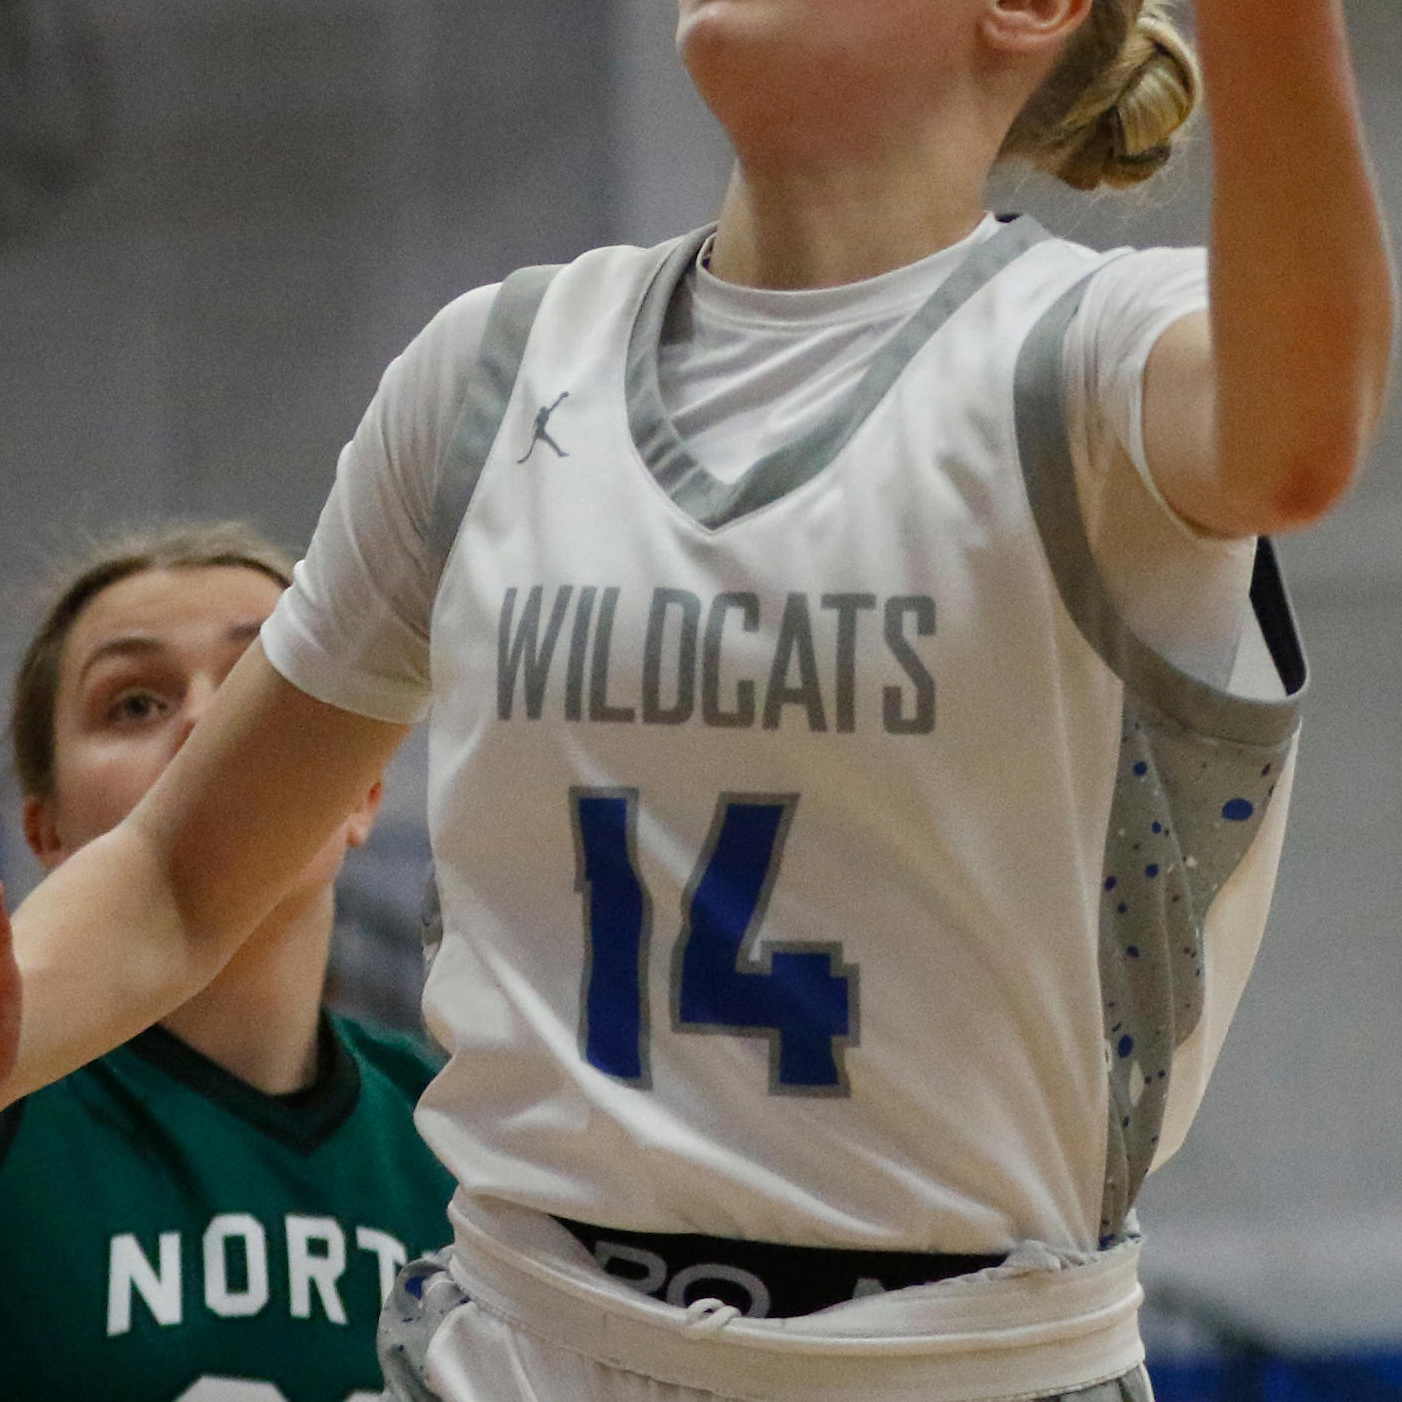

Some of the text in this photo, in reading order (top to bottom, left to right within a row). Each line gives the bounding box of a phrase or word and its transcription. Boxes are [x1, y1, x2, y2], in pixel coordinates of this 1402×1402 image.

[497, 585, 936, 735] WILDCATS
[569, 786, 860, 1097] 14
[107, 1212, 436, 1338] NORT
